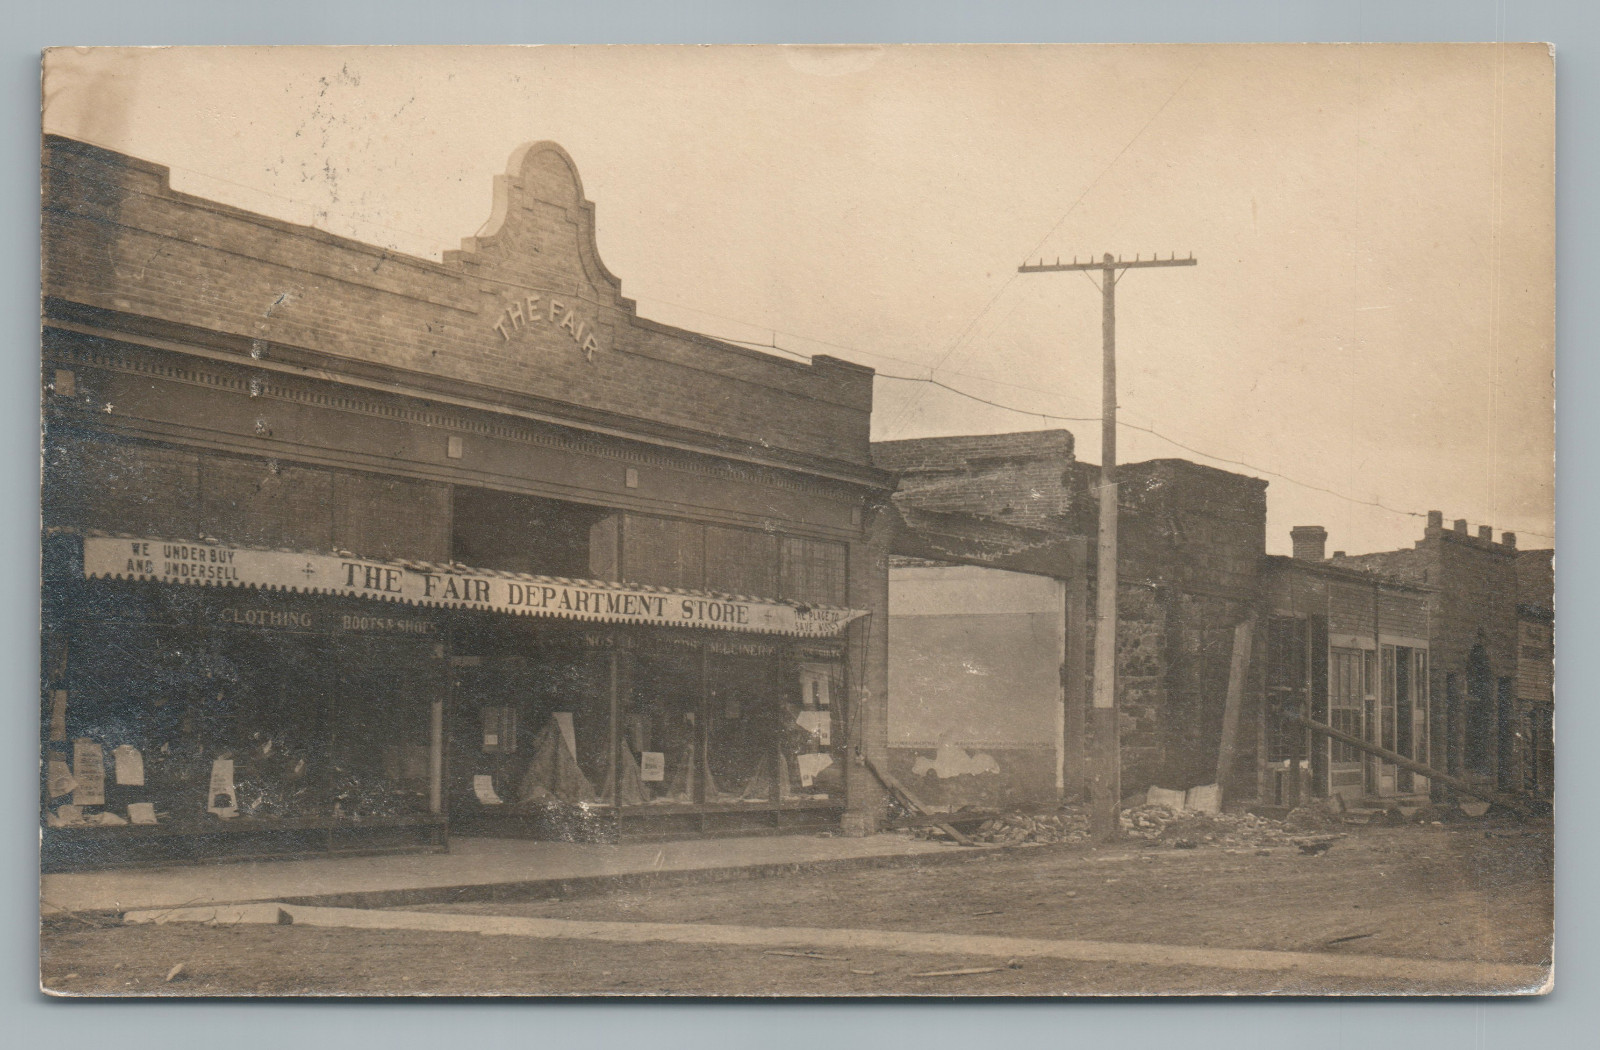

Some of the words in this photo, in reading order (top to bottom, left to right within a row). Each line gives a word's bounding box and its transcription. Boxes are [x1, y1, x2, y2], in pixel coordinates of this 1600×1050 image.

[493, 296, 541, 341] THE
[549, 299, 598, 361] FAIR
[131, 542, 150, 557] WE
[127, 558, 153, 574] AND
[164, 561, 239, 581] UNDERSELL
[341, 562, 403, 594] THE
[422, 573, 490, 603] FAIR
[507, 582, 668, 619] DEPARTMENT
[681, 599, 750, 625] STORE
[220, 608, 312, 628] CLOTHING
[342, 615, 384, 630] BOOTS
